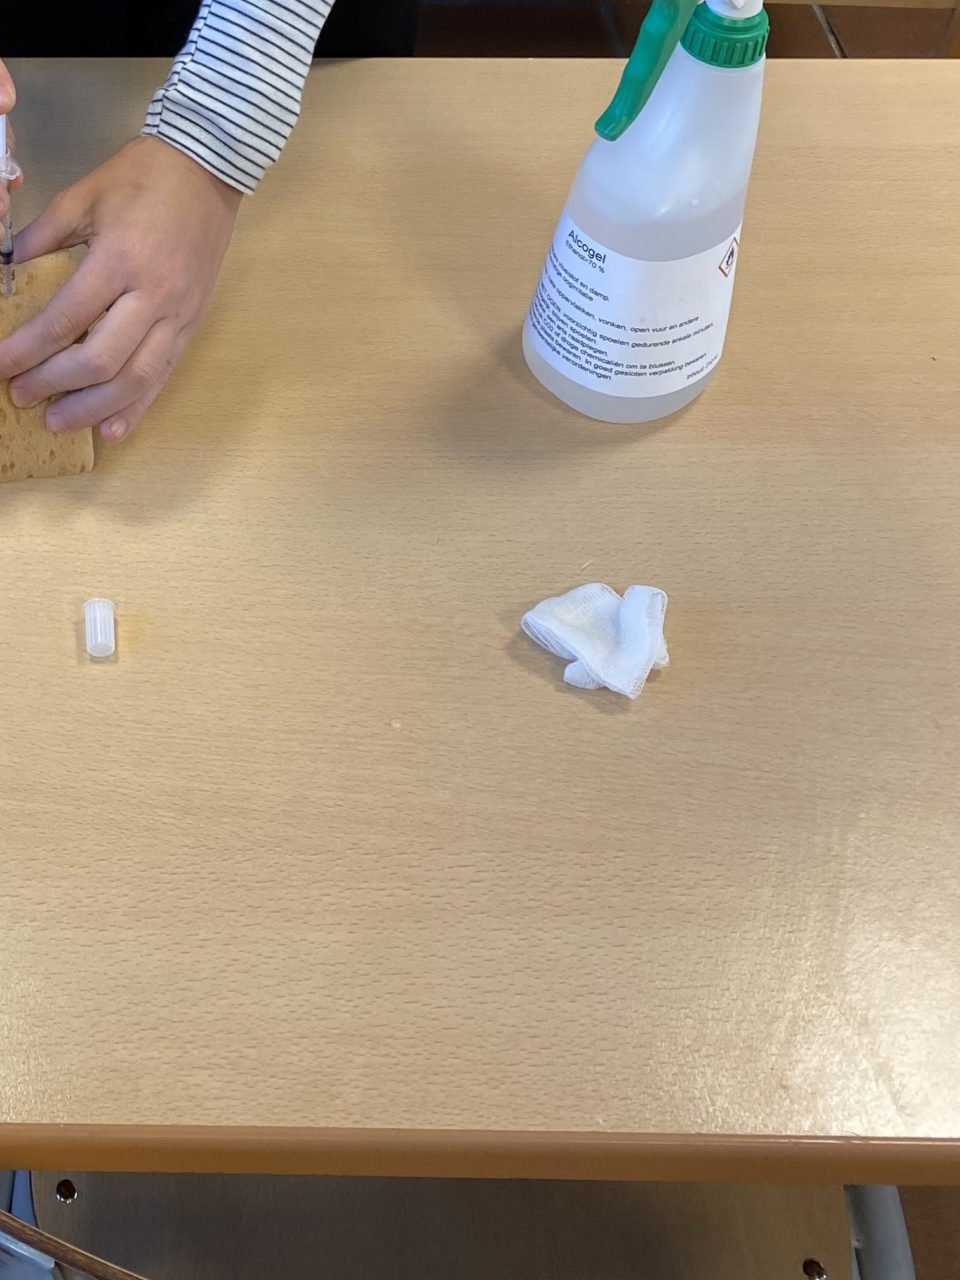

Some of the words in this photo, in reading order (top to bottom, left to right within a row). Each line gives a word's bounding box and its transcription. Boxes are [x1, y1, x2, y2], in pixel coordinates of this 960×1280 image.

[568, 230, 606, 263] Alcogel
[589, 287, 610, 302] damp
[563, 312, 598, 337] voorzichtig
[598, 333, 630, 347] spoelen
[631, 340, 671, 349] gedurende
[598, 317, 628, 331] vonken,
[630, 326, 650, 334] open
[561, 336, 580, 352] droge
[625, 362, 638, 370] om
[639, 362, 647, 370] te
[648, 359, 676, 370] blussen
[562, 353, 612, 381] verordeningen
[593, 362, 613, 374] goed
[614, 369, 647, 378] gesloten
[648, 363, 685, 377] verpakking
